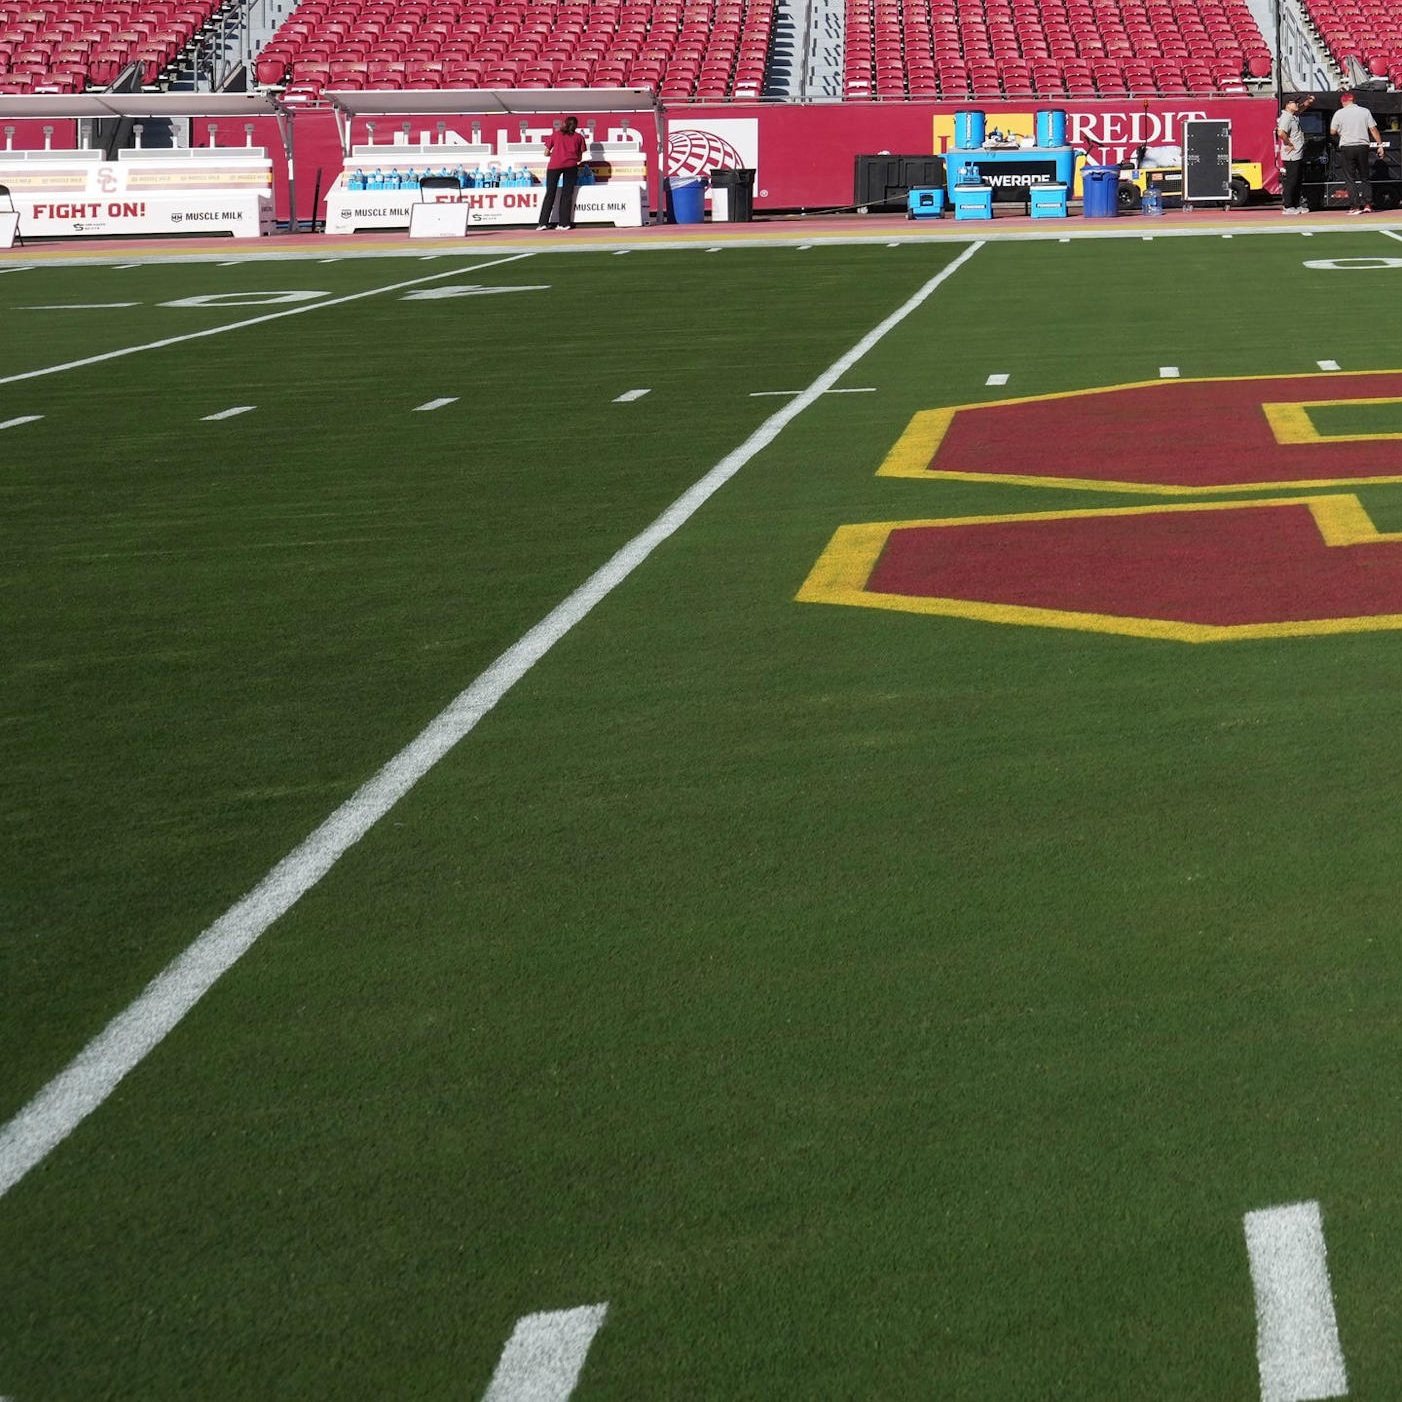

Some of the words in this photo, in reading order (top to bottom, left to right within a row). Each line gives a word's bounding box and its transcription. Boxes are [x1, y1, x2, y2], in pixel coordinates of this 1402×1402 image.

[1064, 111, 1207, 144] REDI
[982, 174, 1050, 187] WERADE
[503, 193, 538, 208] ON!
[574, 203, 605, 212] MUSCLE
[606, 202, 627, 211] MILK
[33, 203, 102, 219] FIGHT
[108, 202, 146, 218] ON!
[185, 212, 220, 222] MUSCLE
[221, 211, 243, 221] MILK
[354, 207, 387, 218] MUSCLE
[389, 206, 410, 217] MILK
